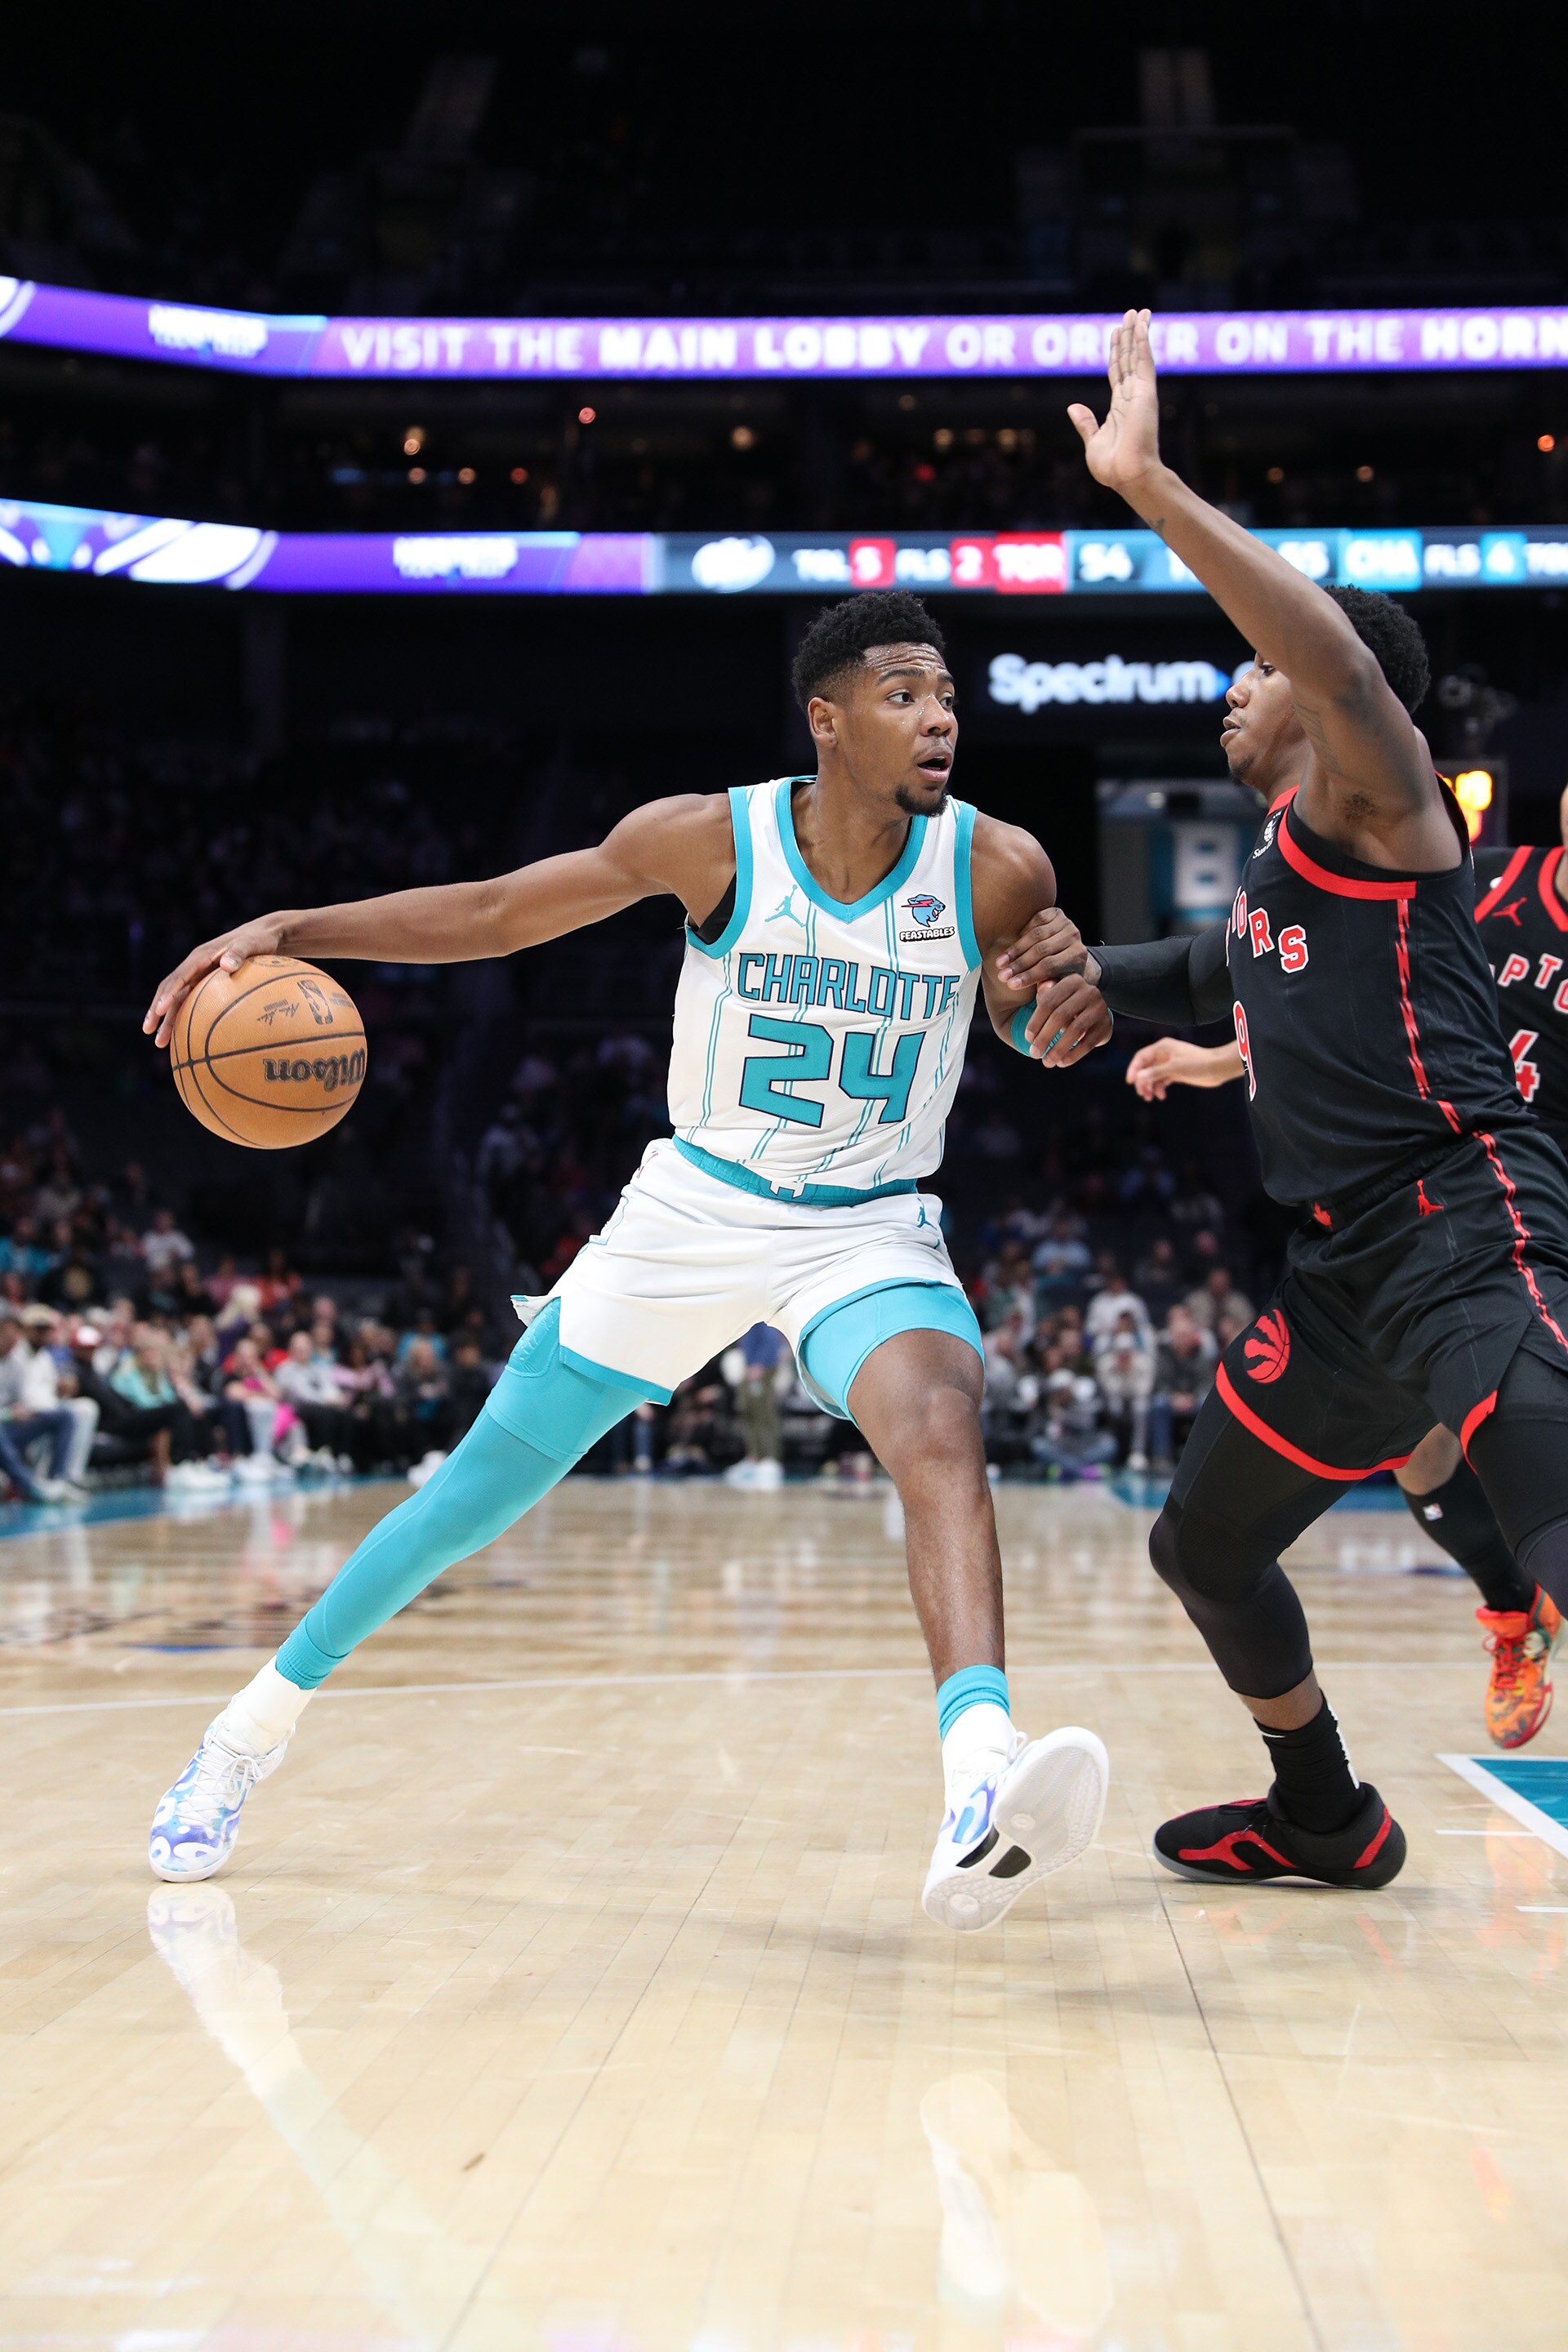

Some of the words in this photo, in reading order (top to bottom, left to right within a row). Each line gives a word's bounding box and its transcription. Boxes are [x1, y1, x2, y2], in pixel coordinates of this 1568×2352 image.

[341, 327, 470, 370] VISIT
[487, 326, 585, 370] THE
[598, 326, 737, 370] MAIN
[753, 325, 930, 369] LOBBY
[945, 323, 1017, 368] OR
[1215, 320, 1288, 365] ON
[1305, 319, 1404, 364] THE
[1421, 316, 1568, 361] HORN
[854, 546, 881, 581] 5
[956, 546, 982, 581] 2
[993, 543, 1063, 581] TOR
[1079, 542, 1133, 581] 54
[1424, 543, 1480, 577] FLS
[1524, 542, 1568, 577] TO
[988, 653, 1218, 715] Spectrum
[899, 926, 956, 942] FEASTABLES
[1227, 887, 1309, 973] ORS
[737, 951, 961, 1021] CHARLOTTE
[262, 1047, 366, 1093] Wilson
[737, 1013, 927, 1129] 24
[1232, 1000, 1257, 1102] 9
[1508, 1028, 1541, 1102] 4
